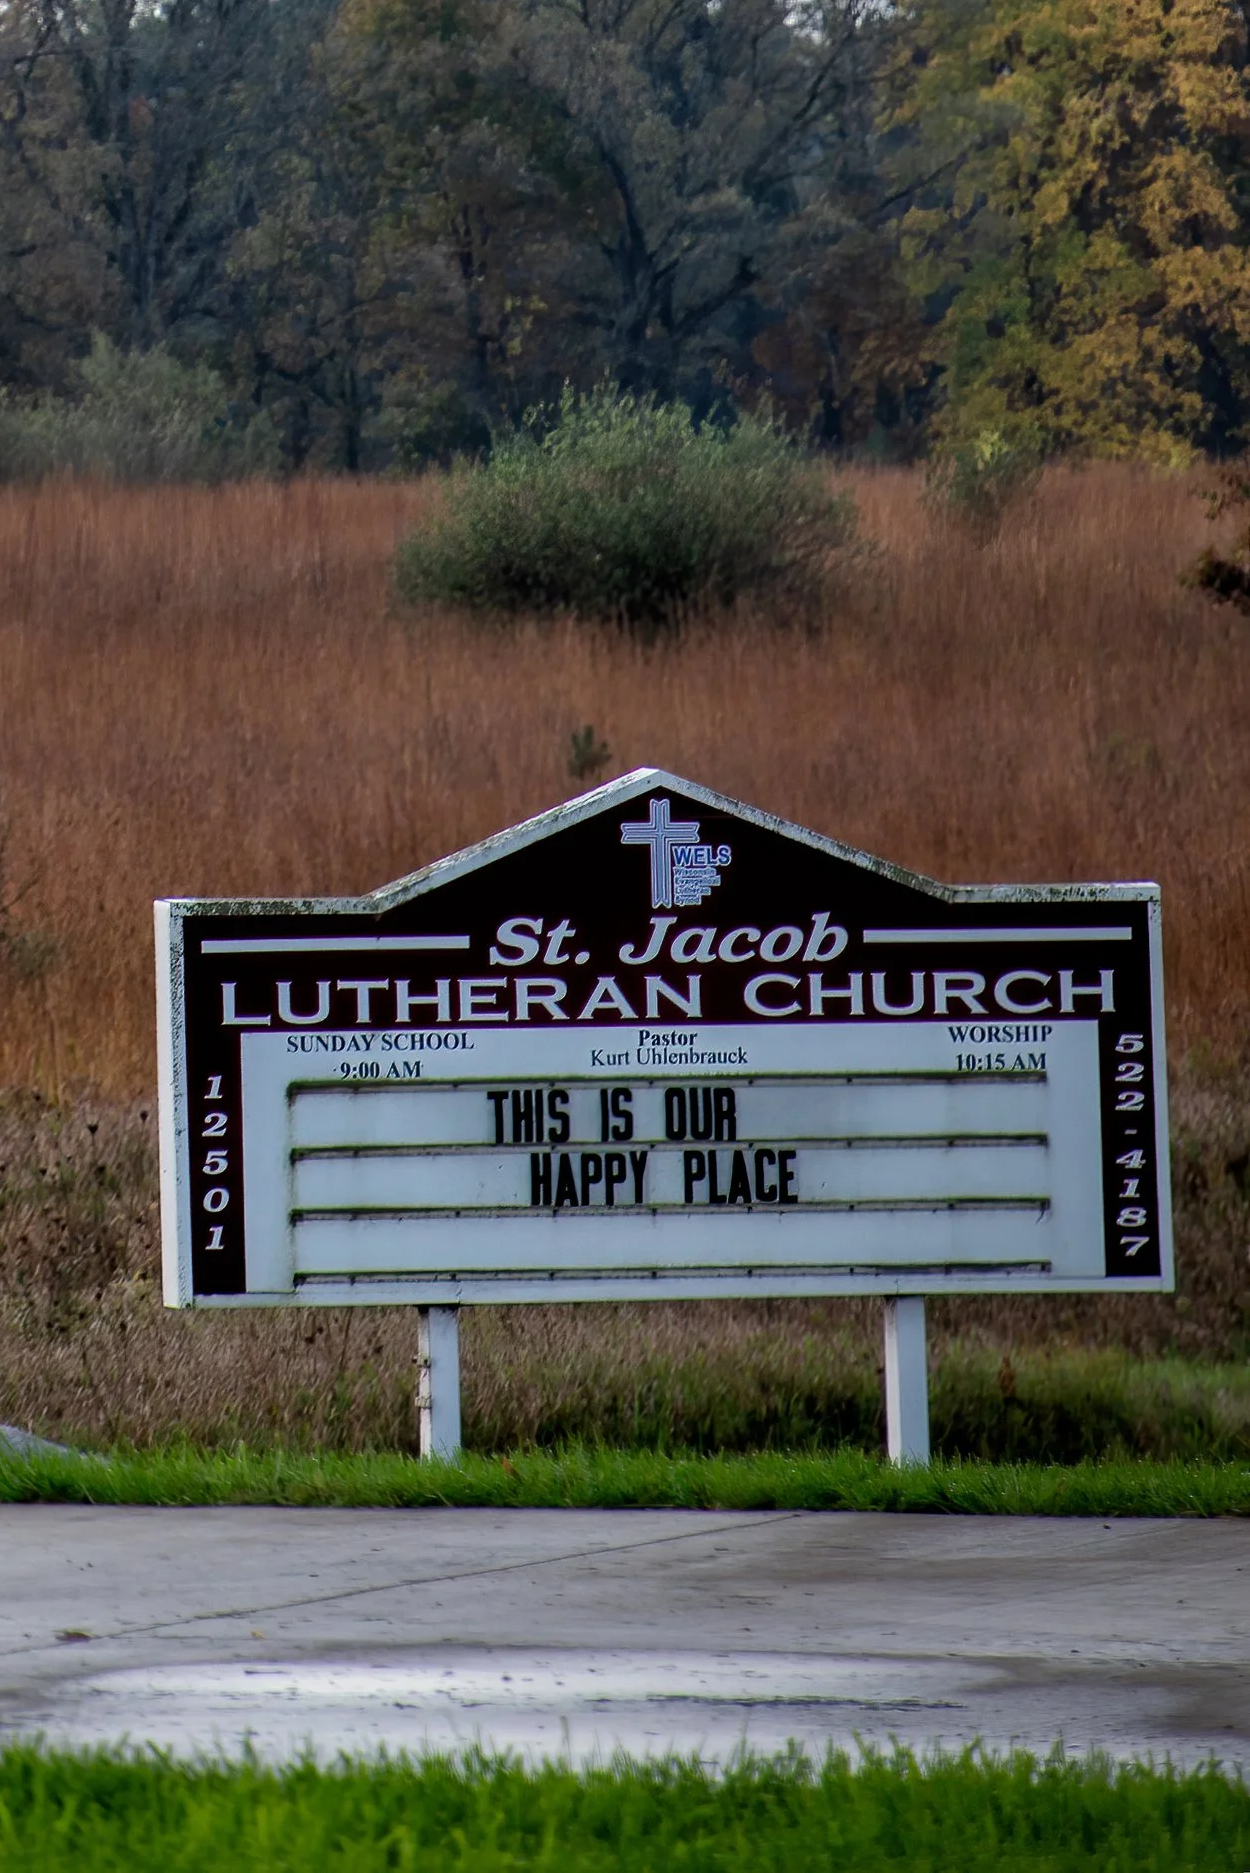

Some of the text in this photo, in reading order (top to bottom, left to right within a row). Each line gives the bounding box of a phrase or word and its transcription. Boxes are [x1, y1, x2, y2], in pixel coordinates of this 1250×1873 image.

[673, 846, 731, 865] WELS
[489, 911, 849, 967] St. Jacob
[220, 969, 1116, 1026] LUTHERAN CHURCH
[286, 1031, 475, 1054] SUNDAY SCHOOL
[638, 1029, 698, 1047] Pastor
[948, 1025, 1053, 1044] WORSHIP
[590, 1045, 748, 1067] Kurt Uhlenbrauck
[955, 1052, 1047, 1071] 10:15 AM
[340, 1060, 422, 1079] 9:00 AM
[487, 1086, 737, 1144] THIS IS OUR
[1115, 1033, 1150, 1257] 522-4187
[201, 1074, 230, 1251] 12501
[530, 1148, 799, 1207] HAPPY PLACE
